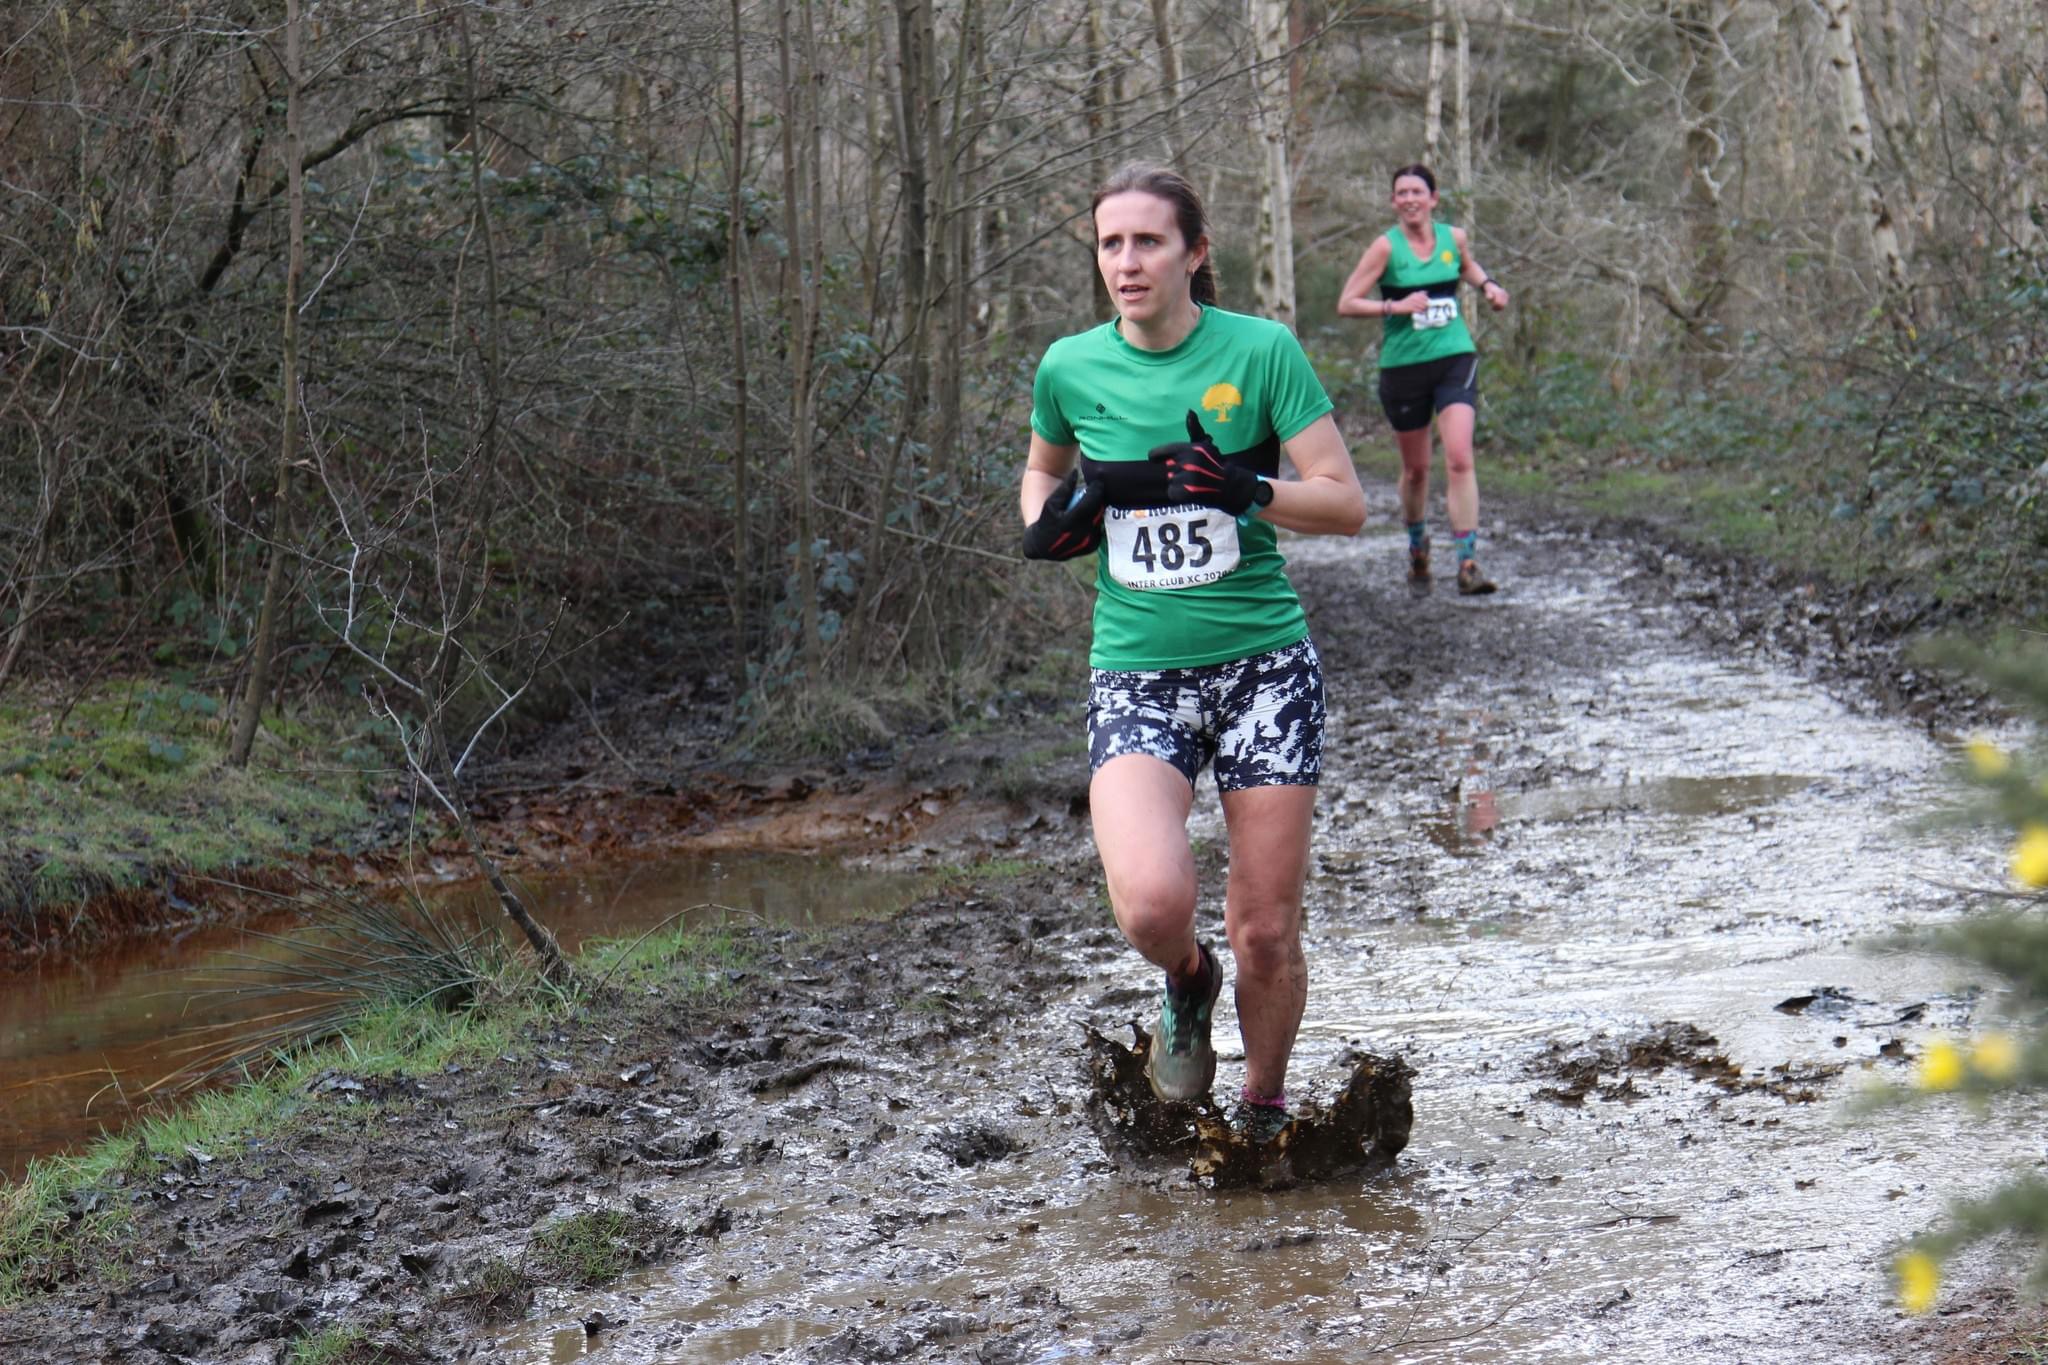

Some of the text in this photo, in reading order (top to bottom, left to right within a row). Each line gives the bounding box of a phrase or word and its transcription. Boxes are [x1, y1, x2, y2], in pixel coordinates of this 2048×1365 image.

[1132, 518, 1213, 573] 485
[1128, 579, 1156, 589] INTER
[1159, 576, 1185, 587] CLUB
[1187, 574, 1201, 584] XC
